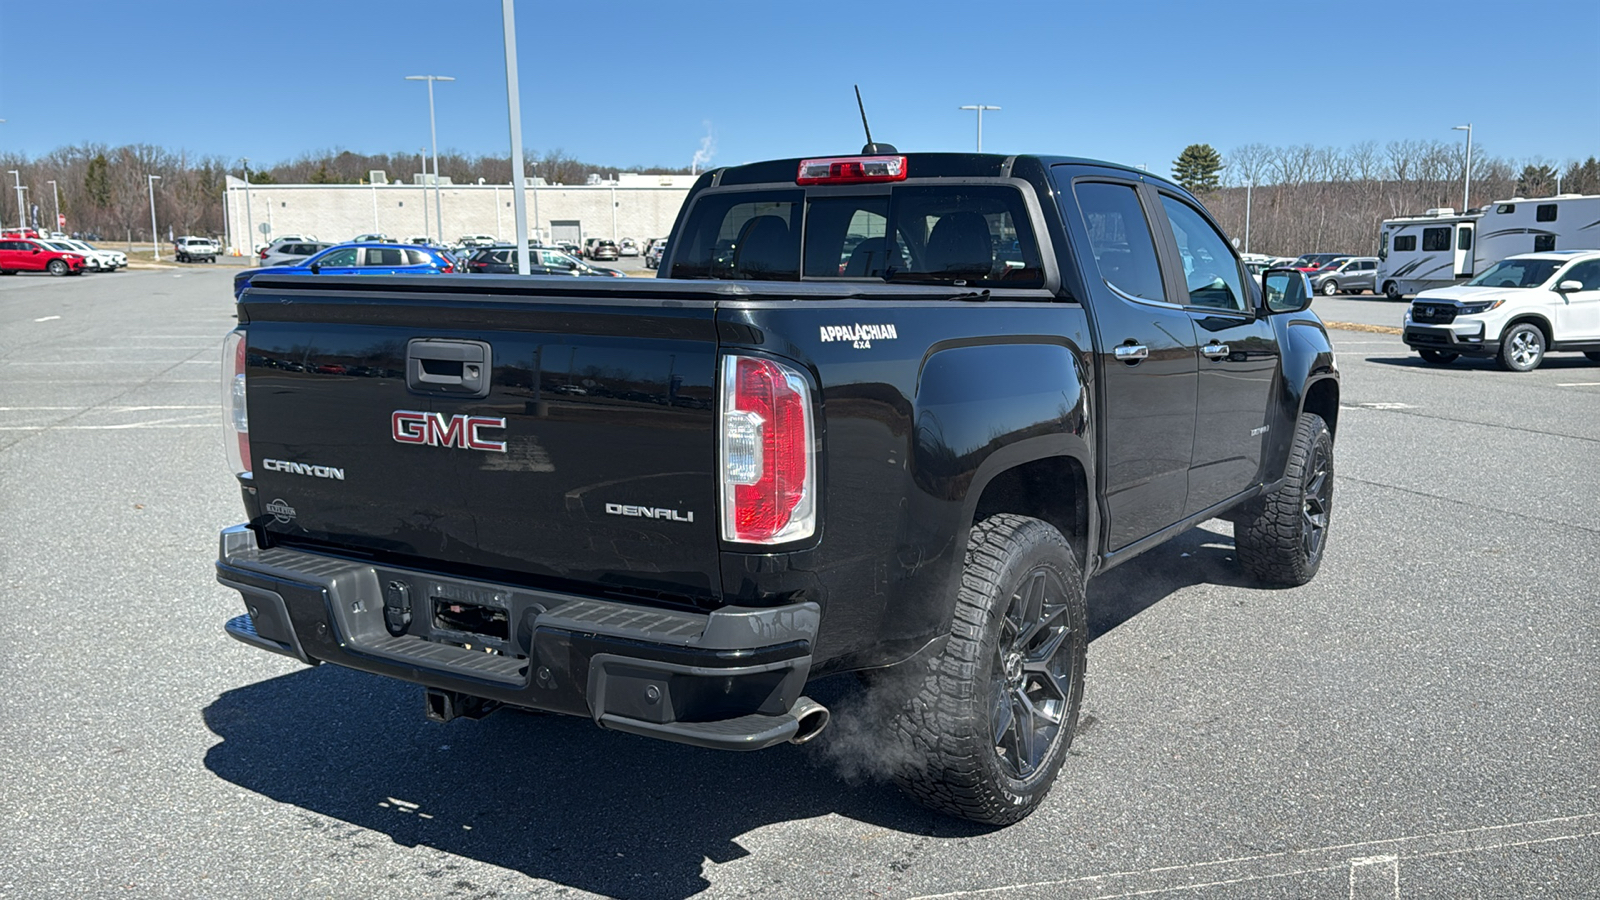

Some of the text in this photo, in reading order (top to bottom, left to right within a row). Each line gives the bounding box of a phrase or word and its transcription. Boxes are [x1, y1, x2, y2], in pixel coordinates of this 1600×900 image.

[820, 322, 897, 342] APPALACHIAN
[392, 410, 507, 453] GMC
[263, 458, 345, 480] CANYON
[605, 503, 694, 523] DENALI
